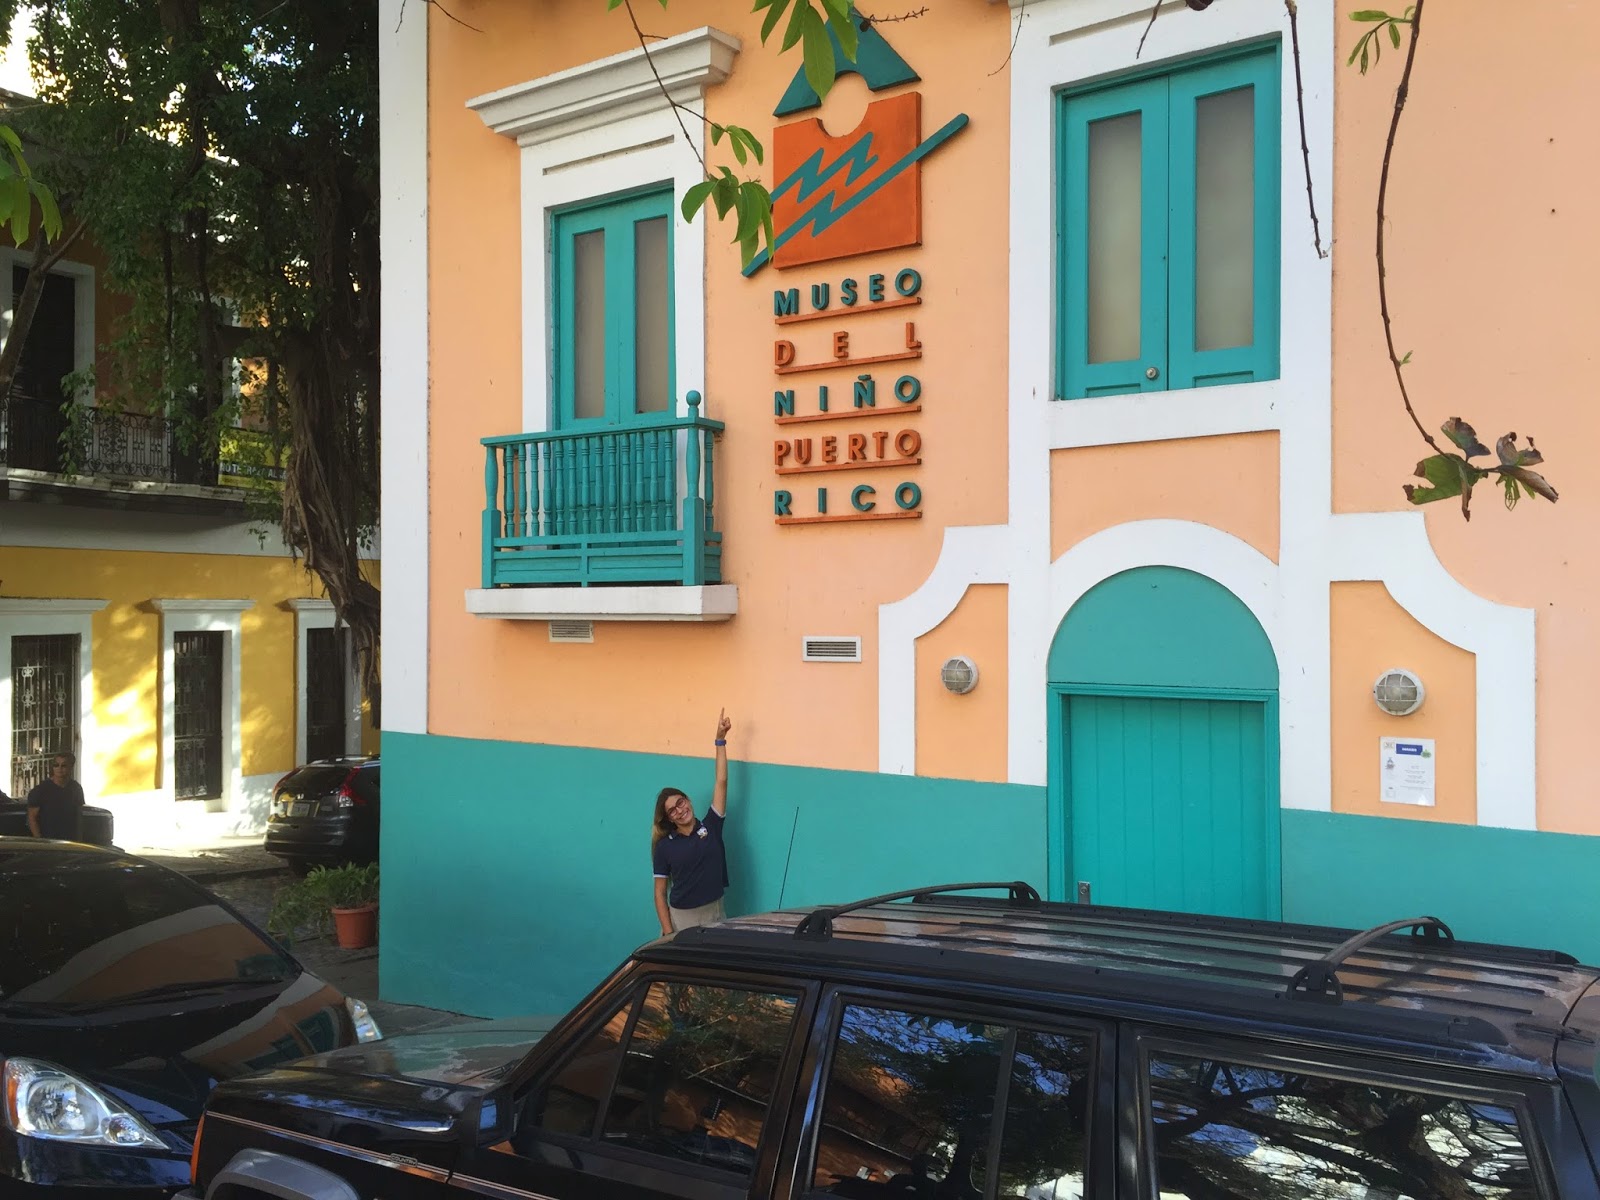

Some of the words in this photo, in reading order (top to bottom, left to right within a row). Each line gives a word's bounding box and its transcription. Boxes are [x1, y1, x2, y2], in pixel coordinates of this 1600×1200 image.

[774, 268, 922, 316] MUSEO
[774, 322, 922, 366] DEL
[774, 374, 922, 416] NIÑO
[774, 429, 922, 466] PUERTO
[774, 482, 922, 516] RICO
